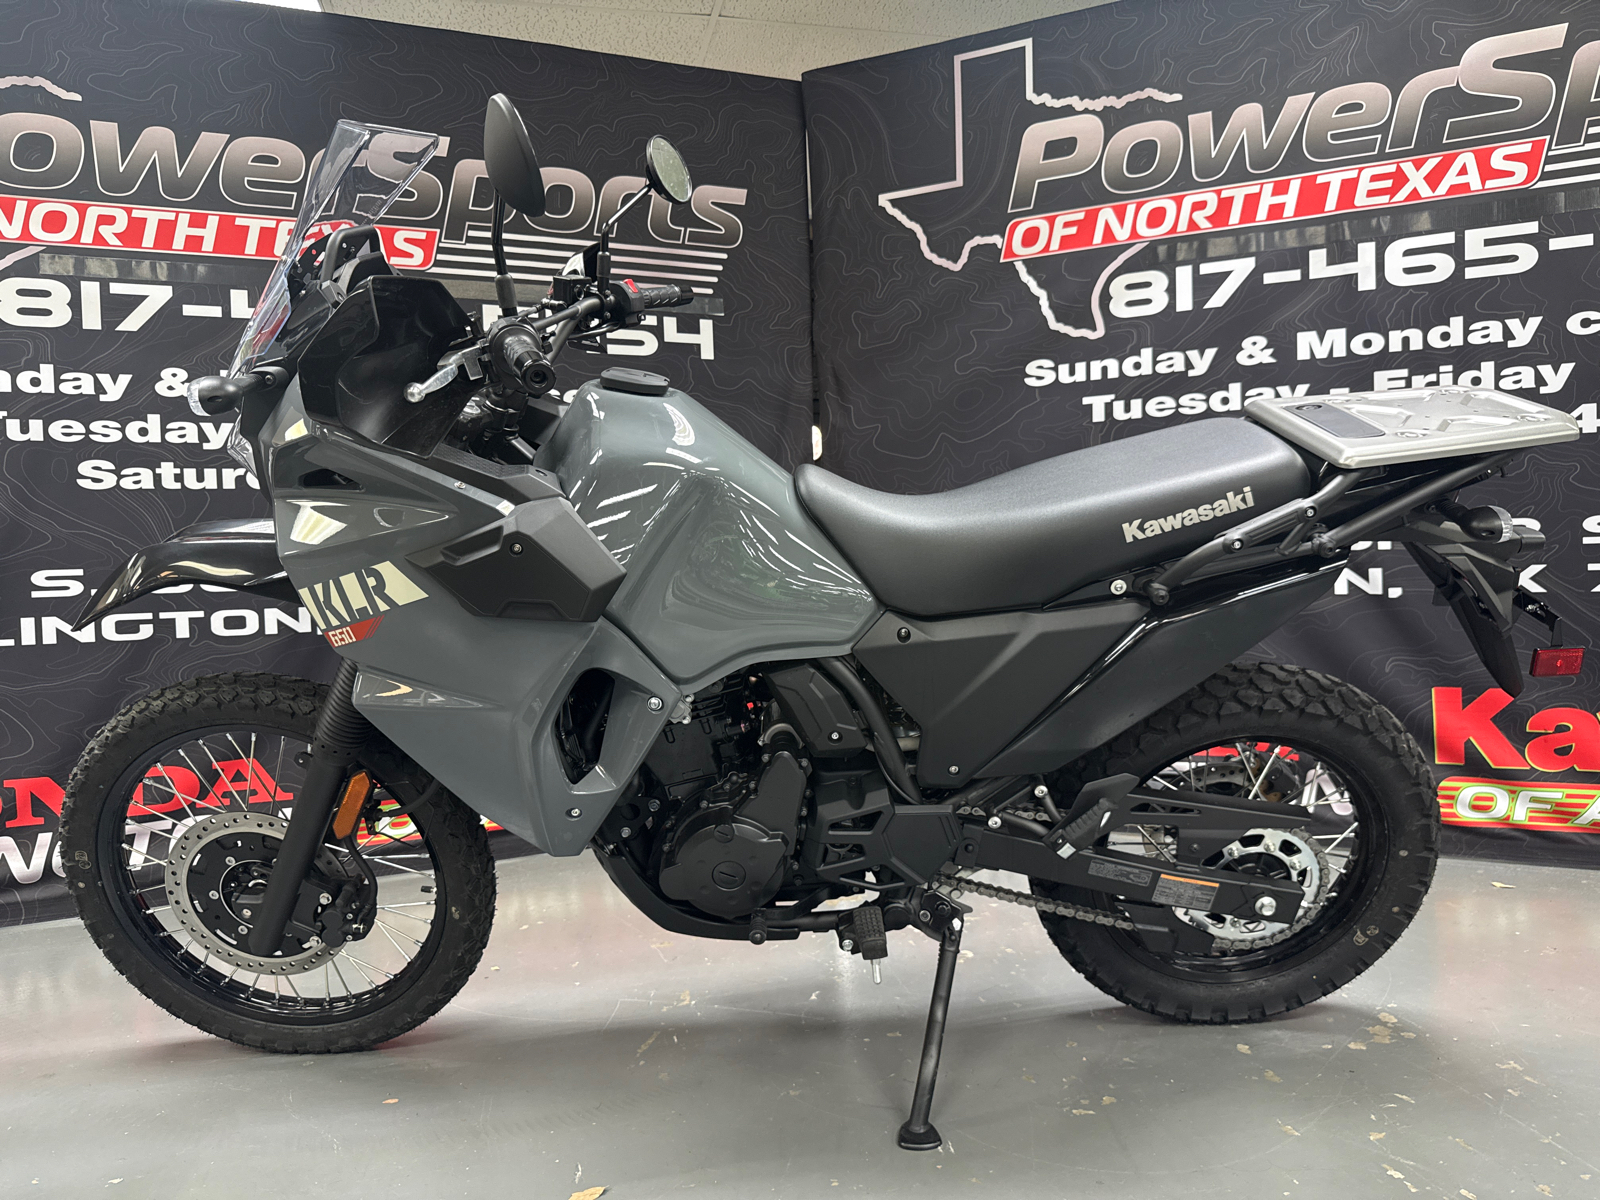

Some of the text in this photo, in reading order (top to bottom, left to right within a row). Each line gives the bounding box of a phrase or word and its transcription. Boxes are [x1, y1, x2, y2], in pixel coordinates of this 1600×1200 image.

[1011, 142, 1533, 256] OF NORTH TEXAS
[235, 217, 427, 266] TEXS
[1023, 347, 1219, 388] Sunday
[1235, 335, 1278, 367] &
[1296, 315, 1544, 361] Monday
[1373, 360, 1577, 395] Friday
[154, 367, 190, 398] &
[0, 410, 235, 451] uesday
[1121, 486, 1255, 541] Kawasaki
[300, 563, 403, 630] KLR
[328, 626, 357, 648] 650
[1432, 686, 1600, 773] Ka
[0, 758, 294, 829] NDA
[1456, 786, 1563, 822] OF
